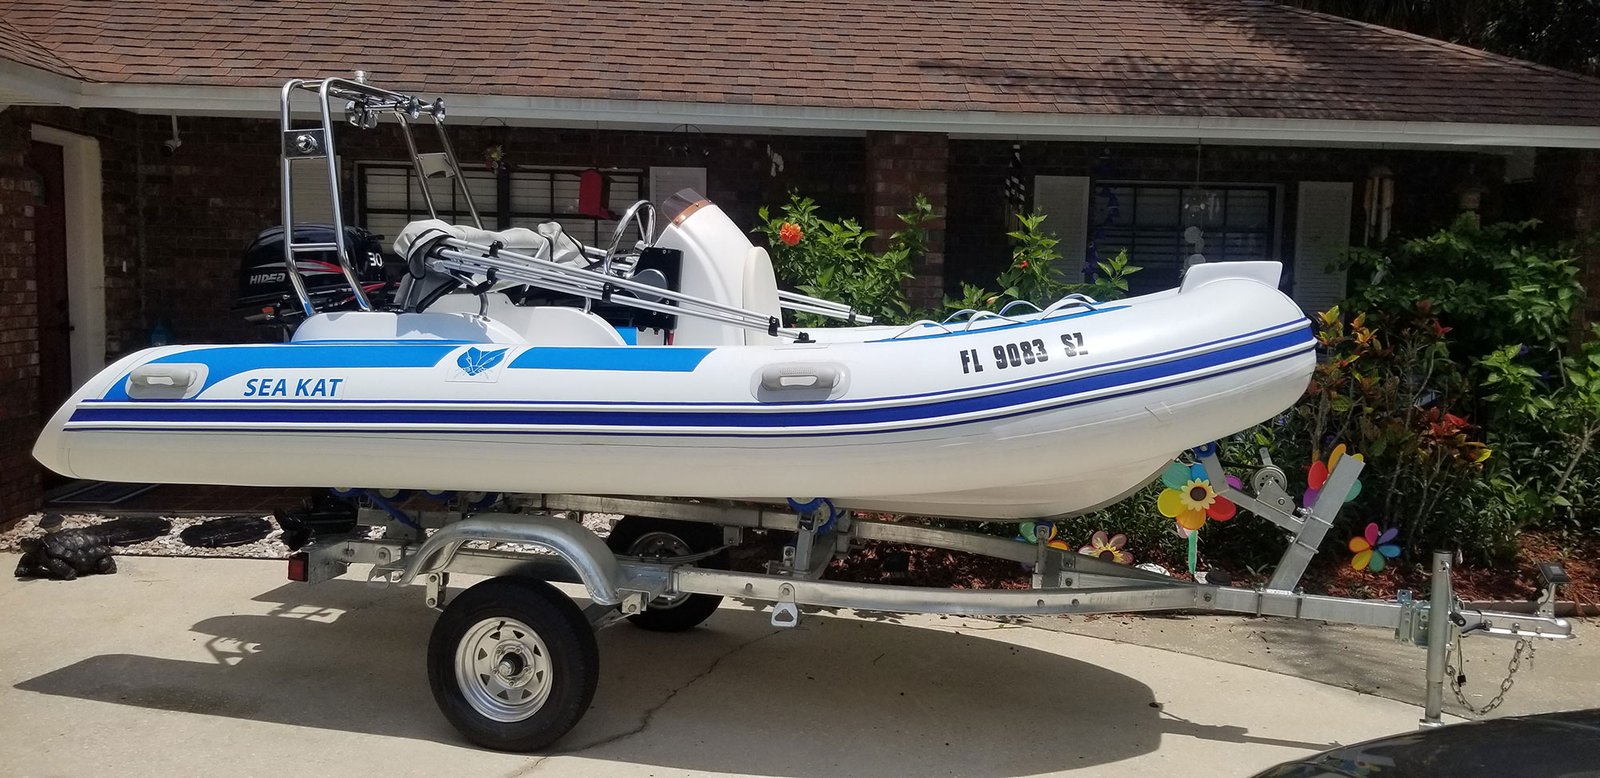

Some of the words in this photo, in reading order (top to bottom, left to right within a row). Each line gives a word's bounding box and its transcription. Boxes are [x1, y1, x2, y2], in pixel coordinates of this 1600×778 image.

[368, 252, 383, 267] 30
[960, 349, 983, 374] FL
[993, 339, 1048, 369] 9083
[1061, 332, 1088, 357] SZ
[243, 378, 287, 397] SEA
[295, 378, 344, 397] KAT
